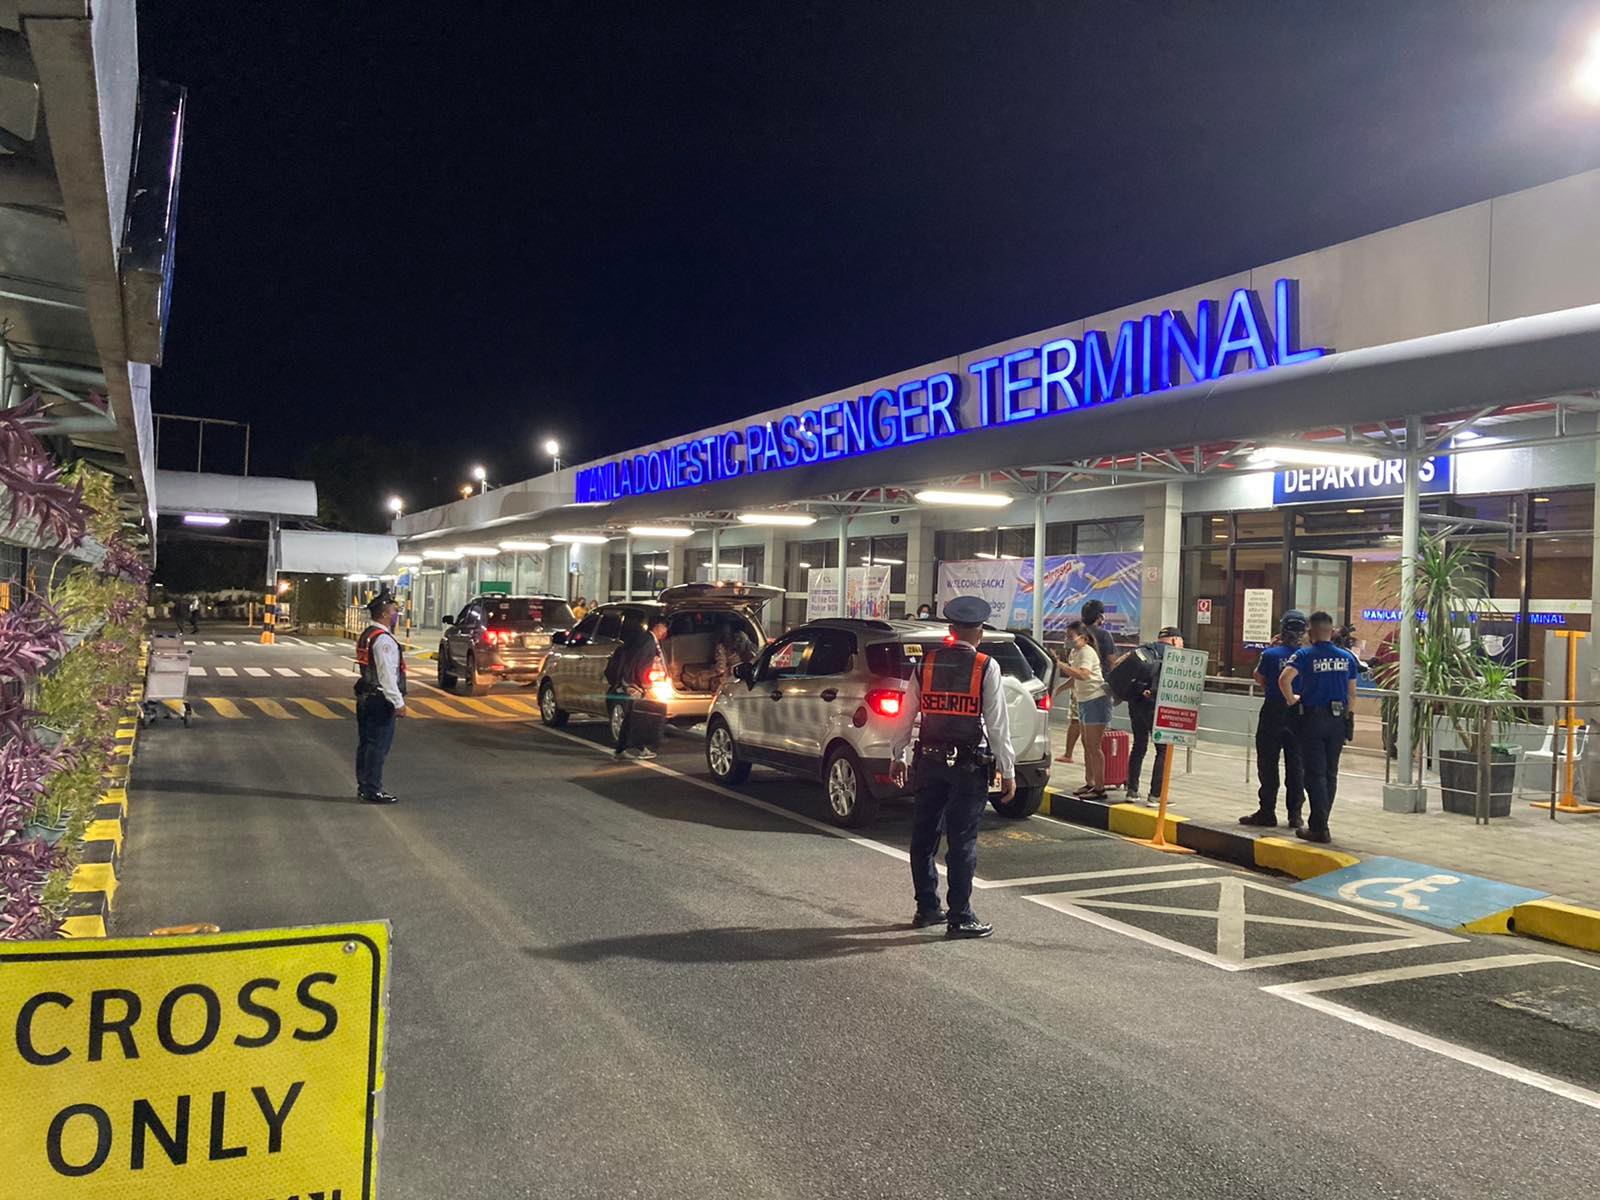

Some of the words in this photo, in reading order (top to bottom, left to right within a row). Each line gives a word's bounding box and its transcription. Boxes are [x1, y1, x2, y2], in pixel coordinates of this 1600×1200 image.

[745, 371, 960, 474] PASSENGER
[969, 278, 1325, 428] TERMINAL
[1284, 456, 1436, 493] DEPARTURS
[1363, 609, 1398, 622] MANILA
[1167, 652, 1186, 664] Five
[1190, 655, 1204, 667] (5)
[1313, 661, 1349, 673] POLICE
[1166, 666, 1202, 679] minutes
[1162, 679, 1202, 692] LOADING
[922, 693, 979, 713] SECURITY
[1160, 691, 1200, 706] UNLOADING
[15, 972, 338, 1066] CROSS
[46, 1080, 305, 1177] ONLY
